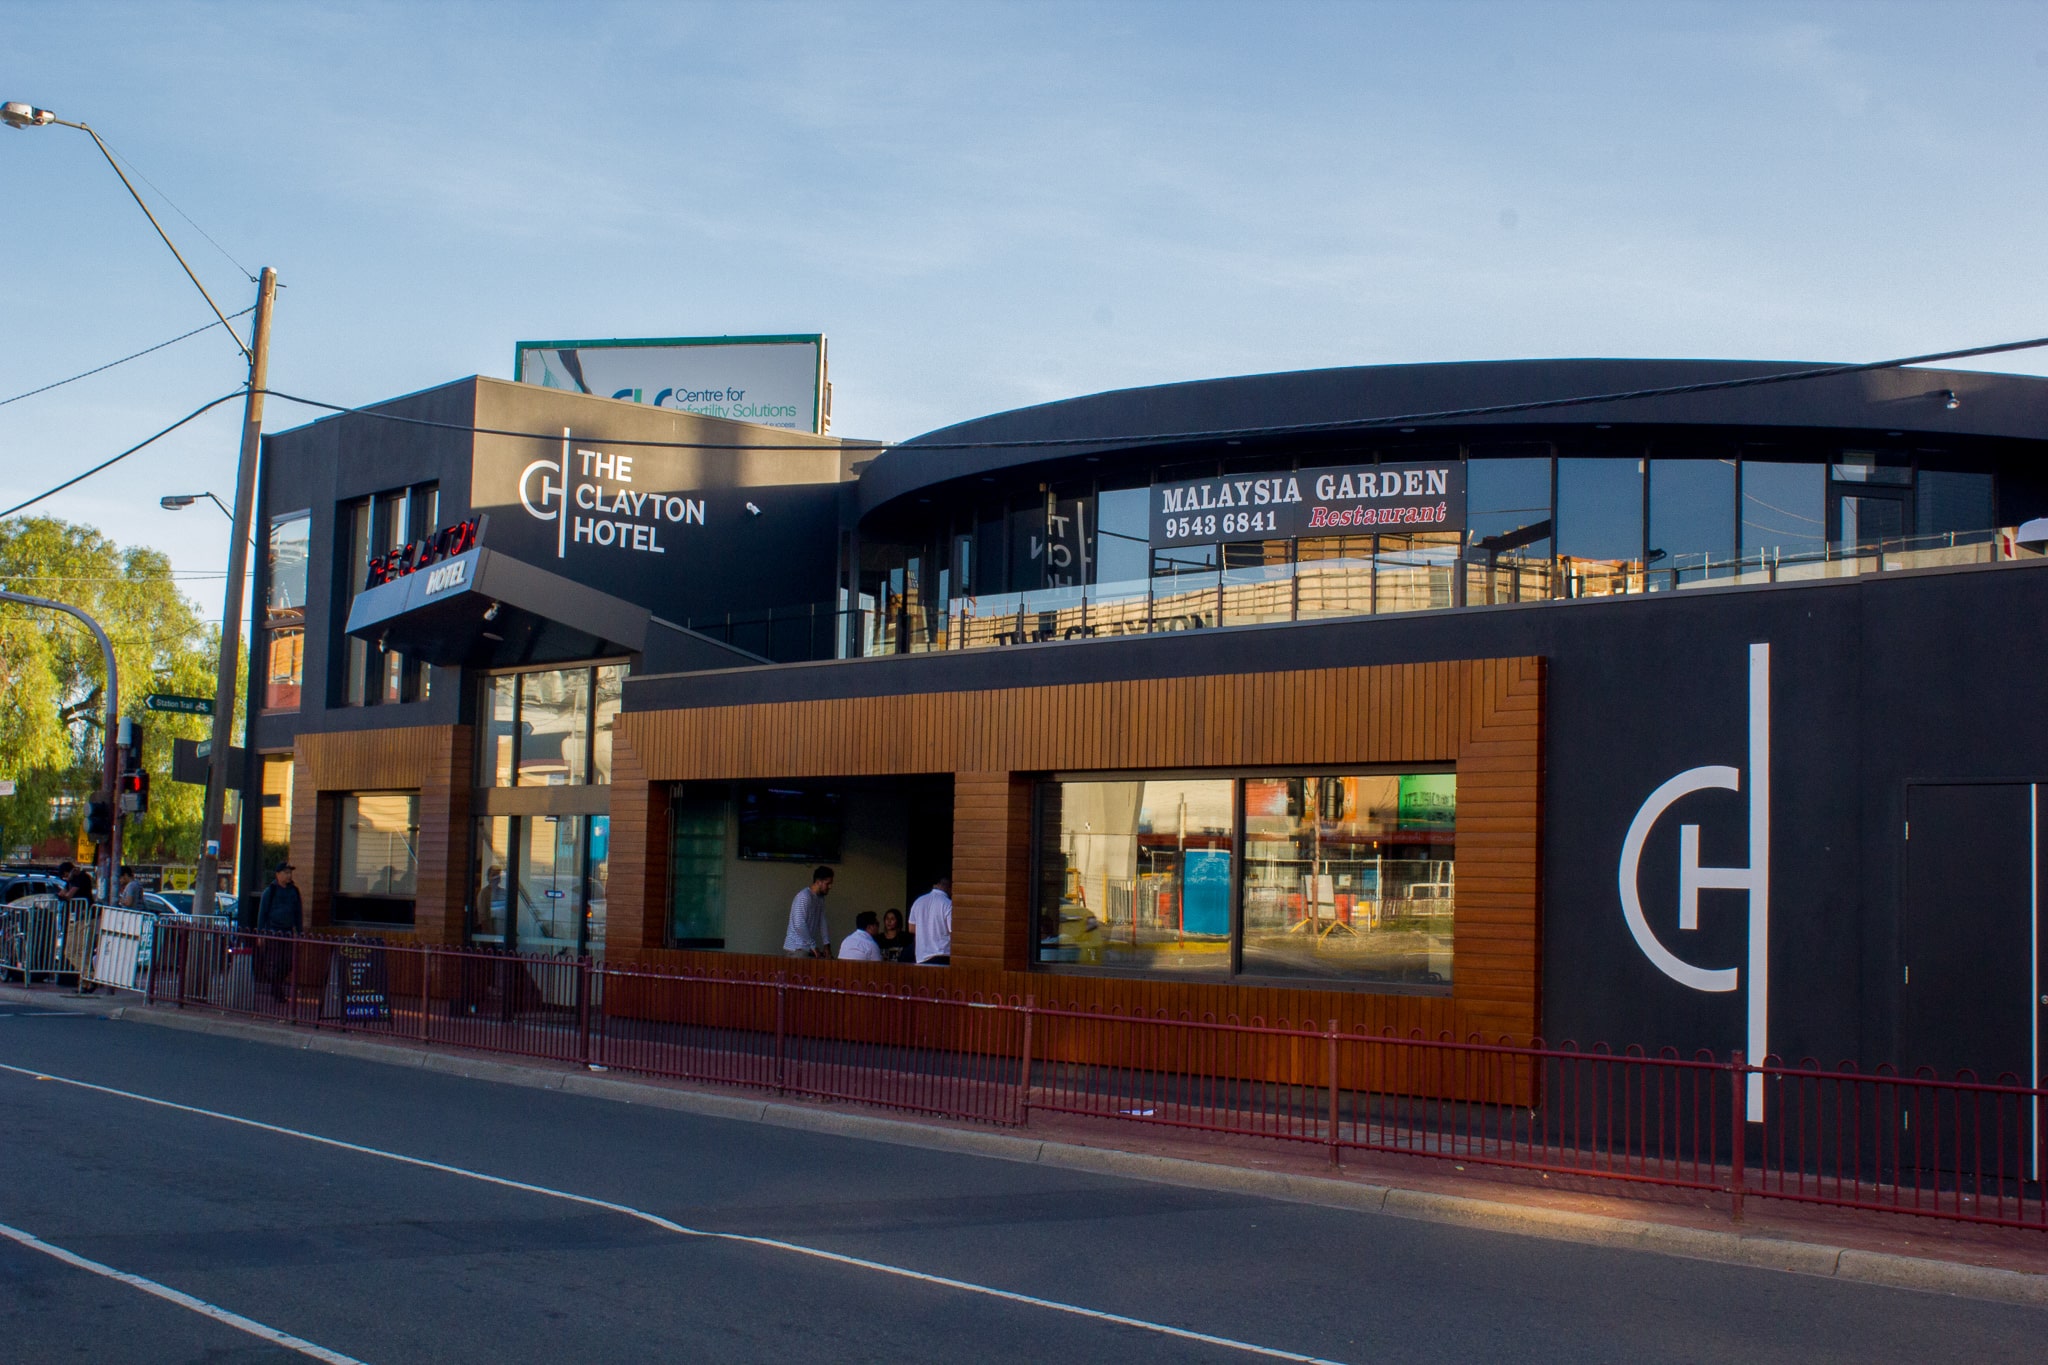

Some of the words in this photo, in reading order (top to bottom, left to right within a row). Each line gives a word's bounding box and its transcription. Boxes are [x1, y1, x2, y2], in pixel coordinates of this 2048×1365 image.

[675, 388, 723, 403] Centre
[726, 386, 746, 402] for
[732, 403, 797, 418] Solutions
[577, 449, 633, 483] THE
[575, 483, 705, 526] CLAYTON
[1162, 477, 1302, 514] MALAYSIA
[1315, 469, 1449, 501] GARDEN
[1166, 515, 1216, 538] 9543
[1222, 510, 1277, 534] 6841
[1308, 501, 1447, 528] Restaurant
[573, 516, 665, 553] HOTEL
[426, 560, 467, 595] HOTEL
[156, 698, 179, 708] Station
